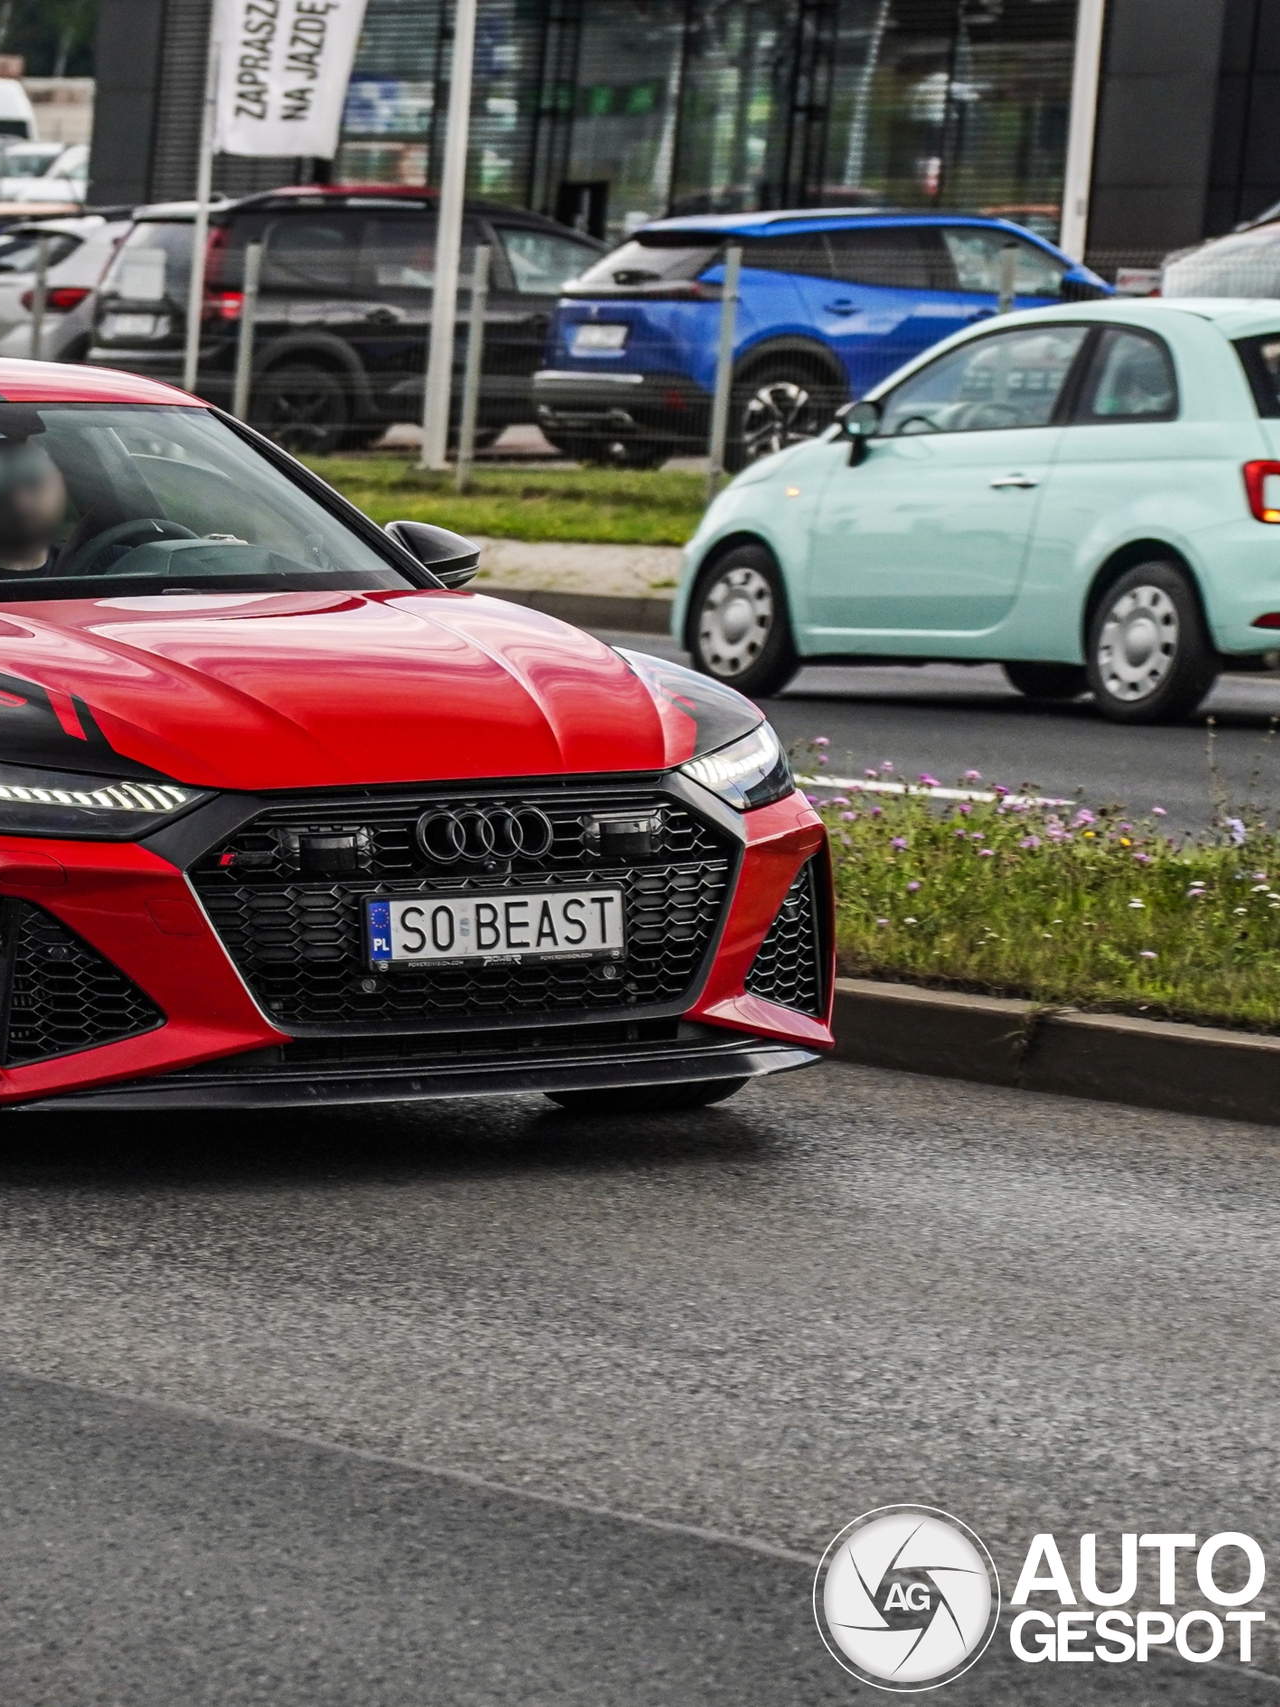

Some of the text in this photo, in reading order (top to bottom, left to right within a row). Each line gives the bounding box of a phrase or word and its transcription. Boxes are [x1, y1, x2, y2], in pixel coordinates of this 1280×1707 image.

[235, 0, 280, 120] ZAPRASZ
[281, 0, 339, 121] NA JAZDĘ
[373, 938, 390, 952] PL
[476, 896, 615, 951] BEAST
[483, 954, 522, 967] POWER
